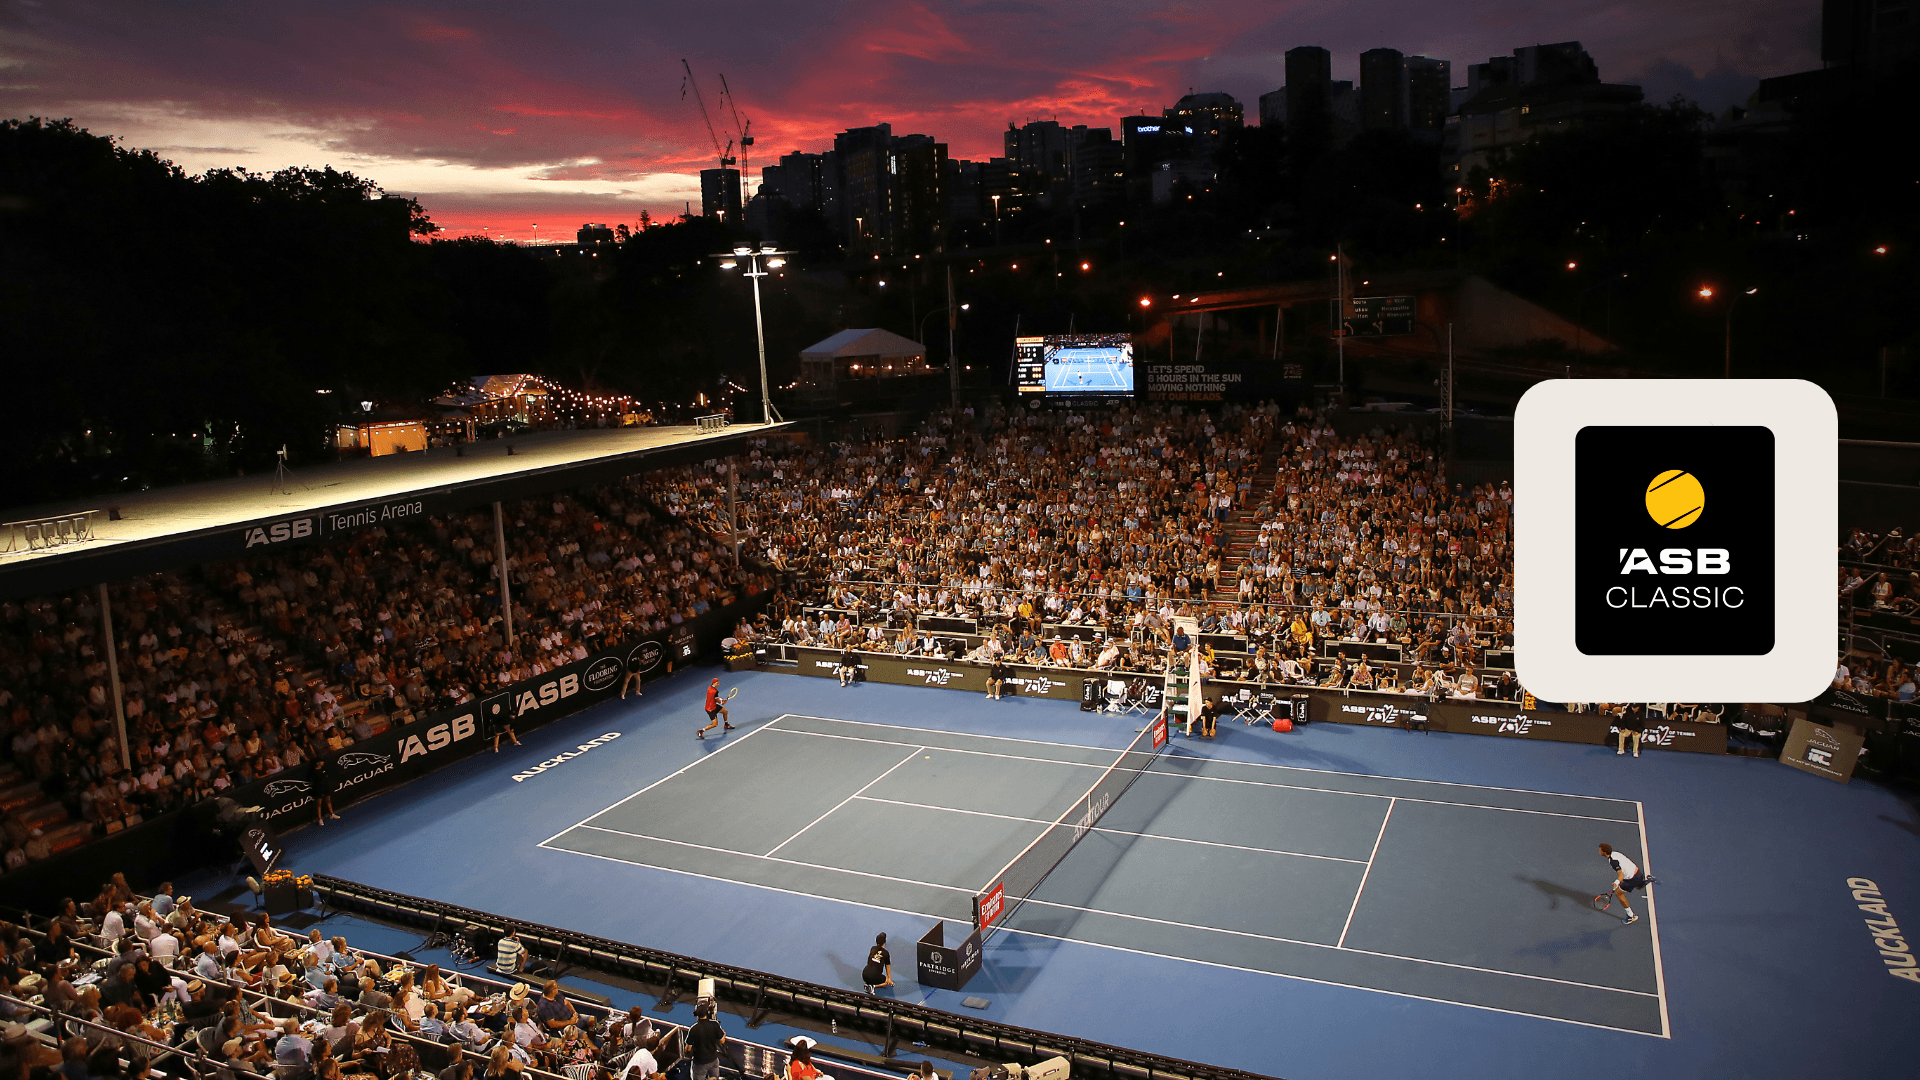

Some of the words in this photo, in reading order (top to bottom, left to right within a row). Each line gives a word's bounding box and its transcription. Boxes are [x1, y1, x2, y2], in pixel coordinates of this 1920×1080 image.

[1137, 125, 1161, 133] brother
[1147, 365, 1173, 374] LET'S
[1174, 365, 1205, 374] SPEND
[1147, 374, 1155, 382] 8
[1156, 374, 1188, 382] HOURS
[1190, 374, 1199, 382] IN
[1201, 374, 1220, 382] THE
[1221, 374, 1242, 382] SUN
[1147, 383, 1184, 392] MOVING
[1185, 383, 1227, 392] NOTHING
[1148, 393, 1167, 401] BUT
[1168, 393, 1188, 401] OUR
[245, 518, 313, 549] ASB
[329, 507, 377, 531] Tennis
[381, 501, 423, 521] Arena
[588, 664, 618, 682] FLOORING
[515, 673, 580, 717] ASB
[1830, 702, 1869, 715] JAGUAR
[398, 713, 476, 764] ASB
[1806, 738, 1840, 751] JAGUAR
[511, 731, 623, 783] AUCKLAND
[334, 762, 395, 793] JAGUAR
[264, 795, 315, 821] JAGUA
[981, 889, 1004, 917] Emirates
[1846, 877, 1920, 984] AUCKLAND
[919, 960, 956, 974] PARTRIDGE
